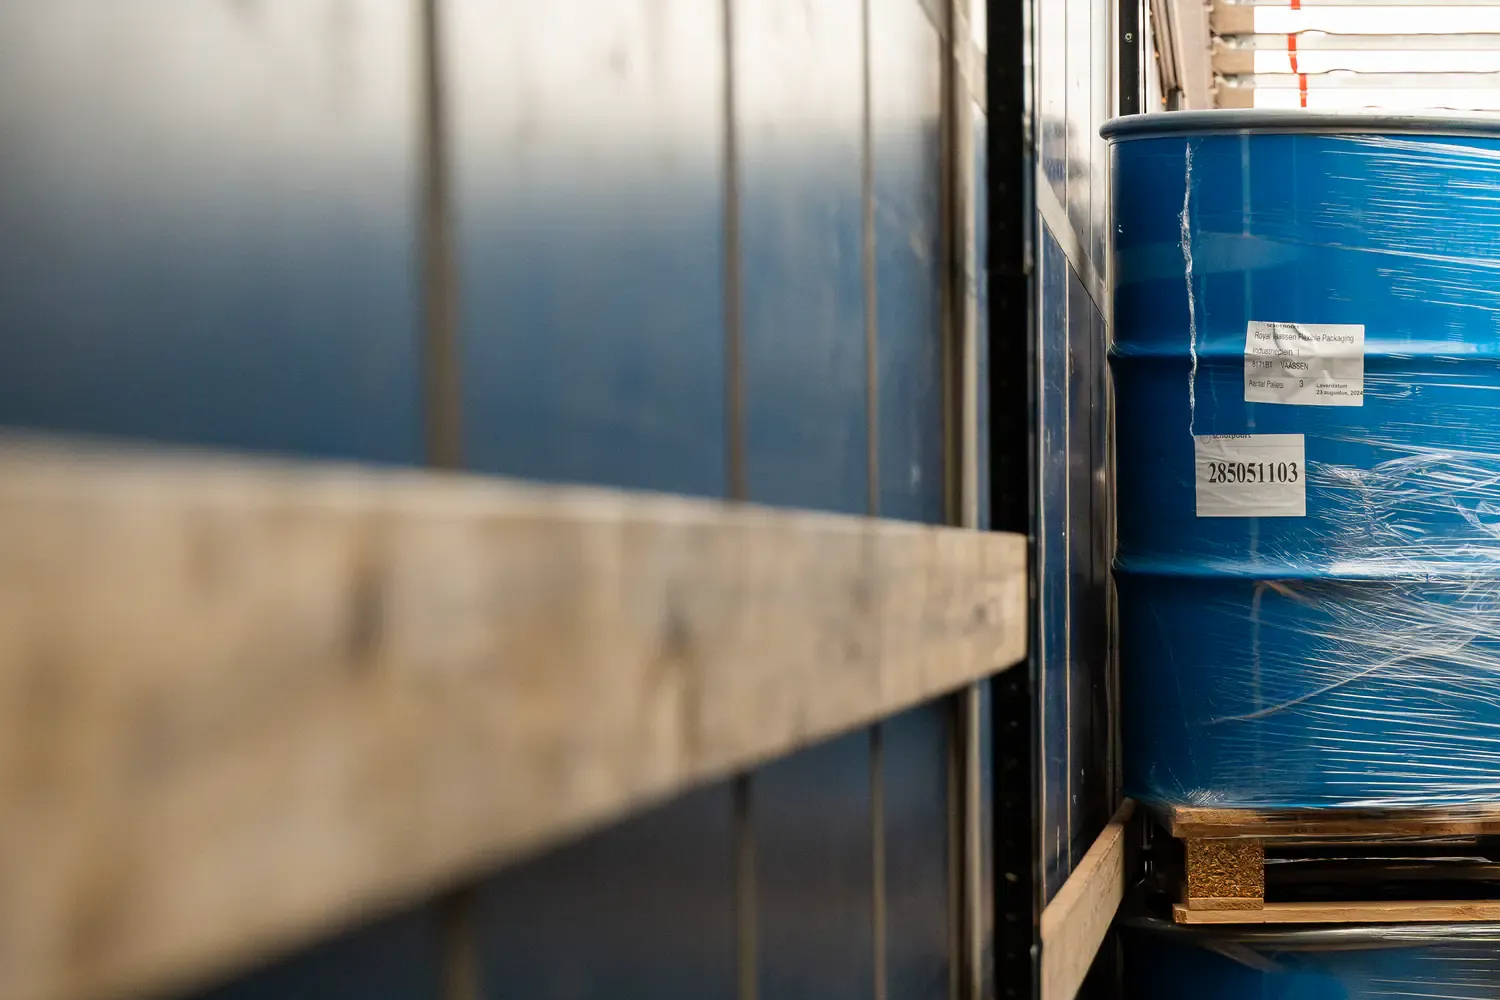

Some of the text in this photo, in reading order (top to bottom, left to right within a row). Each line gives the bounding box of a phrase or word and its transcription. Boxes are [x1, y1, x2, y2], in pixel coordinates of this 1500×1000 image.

[1254, 331, 1271, 341] Royal
[1322, 334, 1355, 343] Packaging
[1280, 361, 1309, 370] VAASSEN
[1299, 380, 1304, 388] 3
[1208, 462, 1298, 483] 285051103
